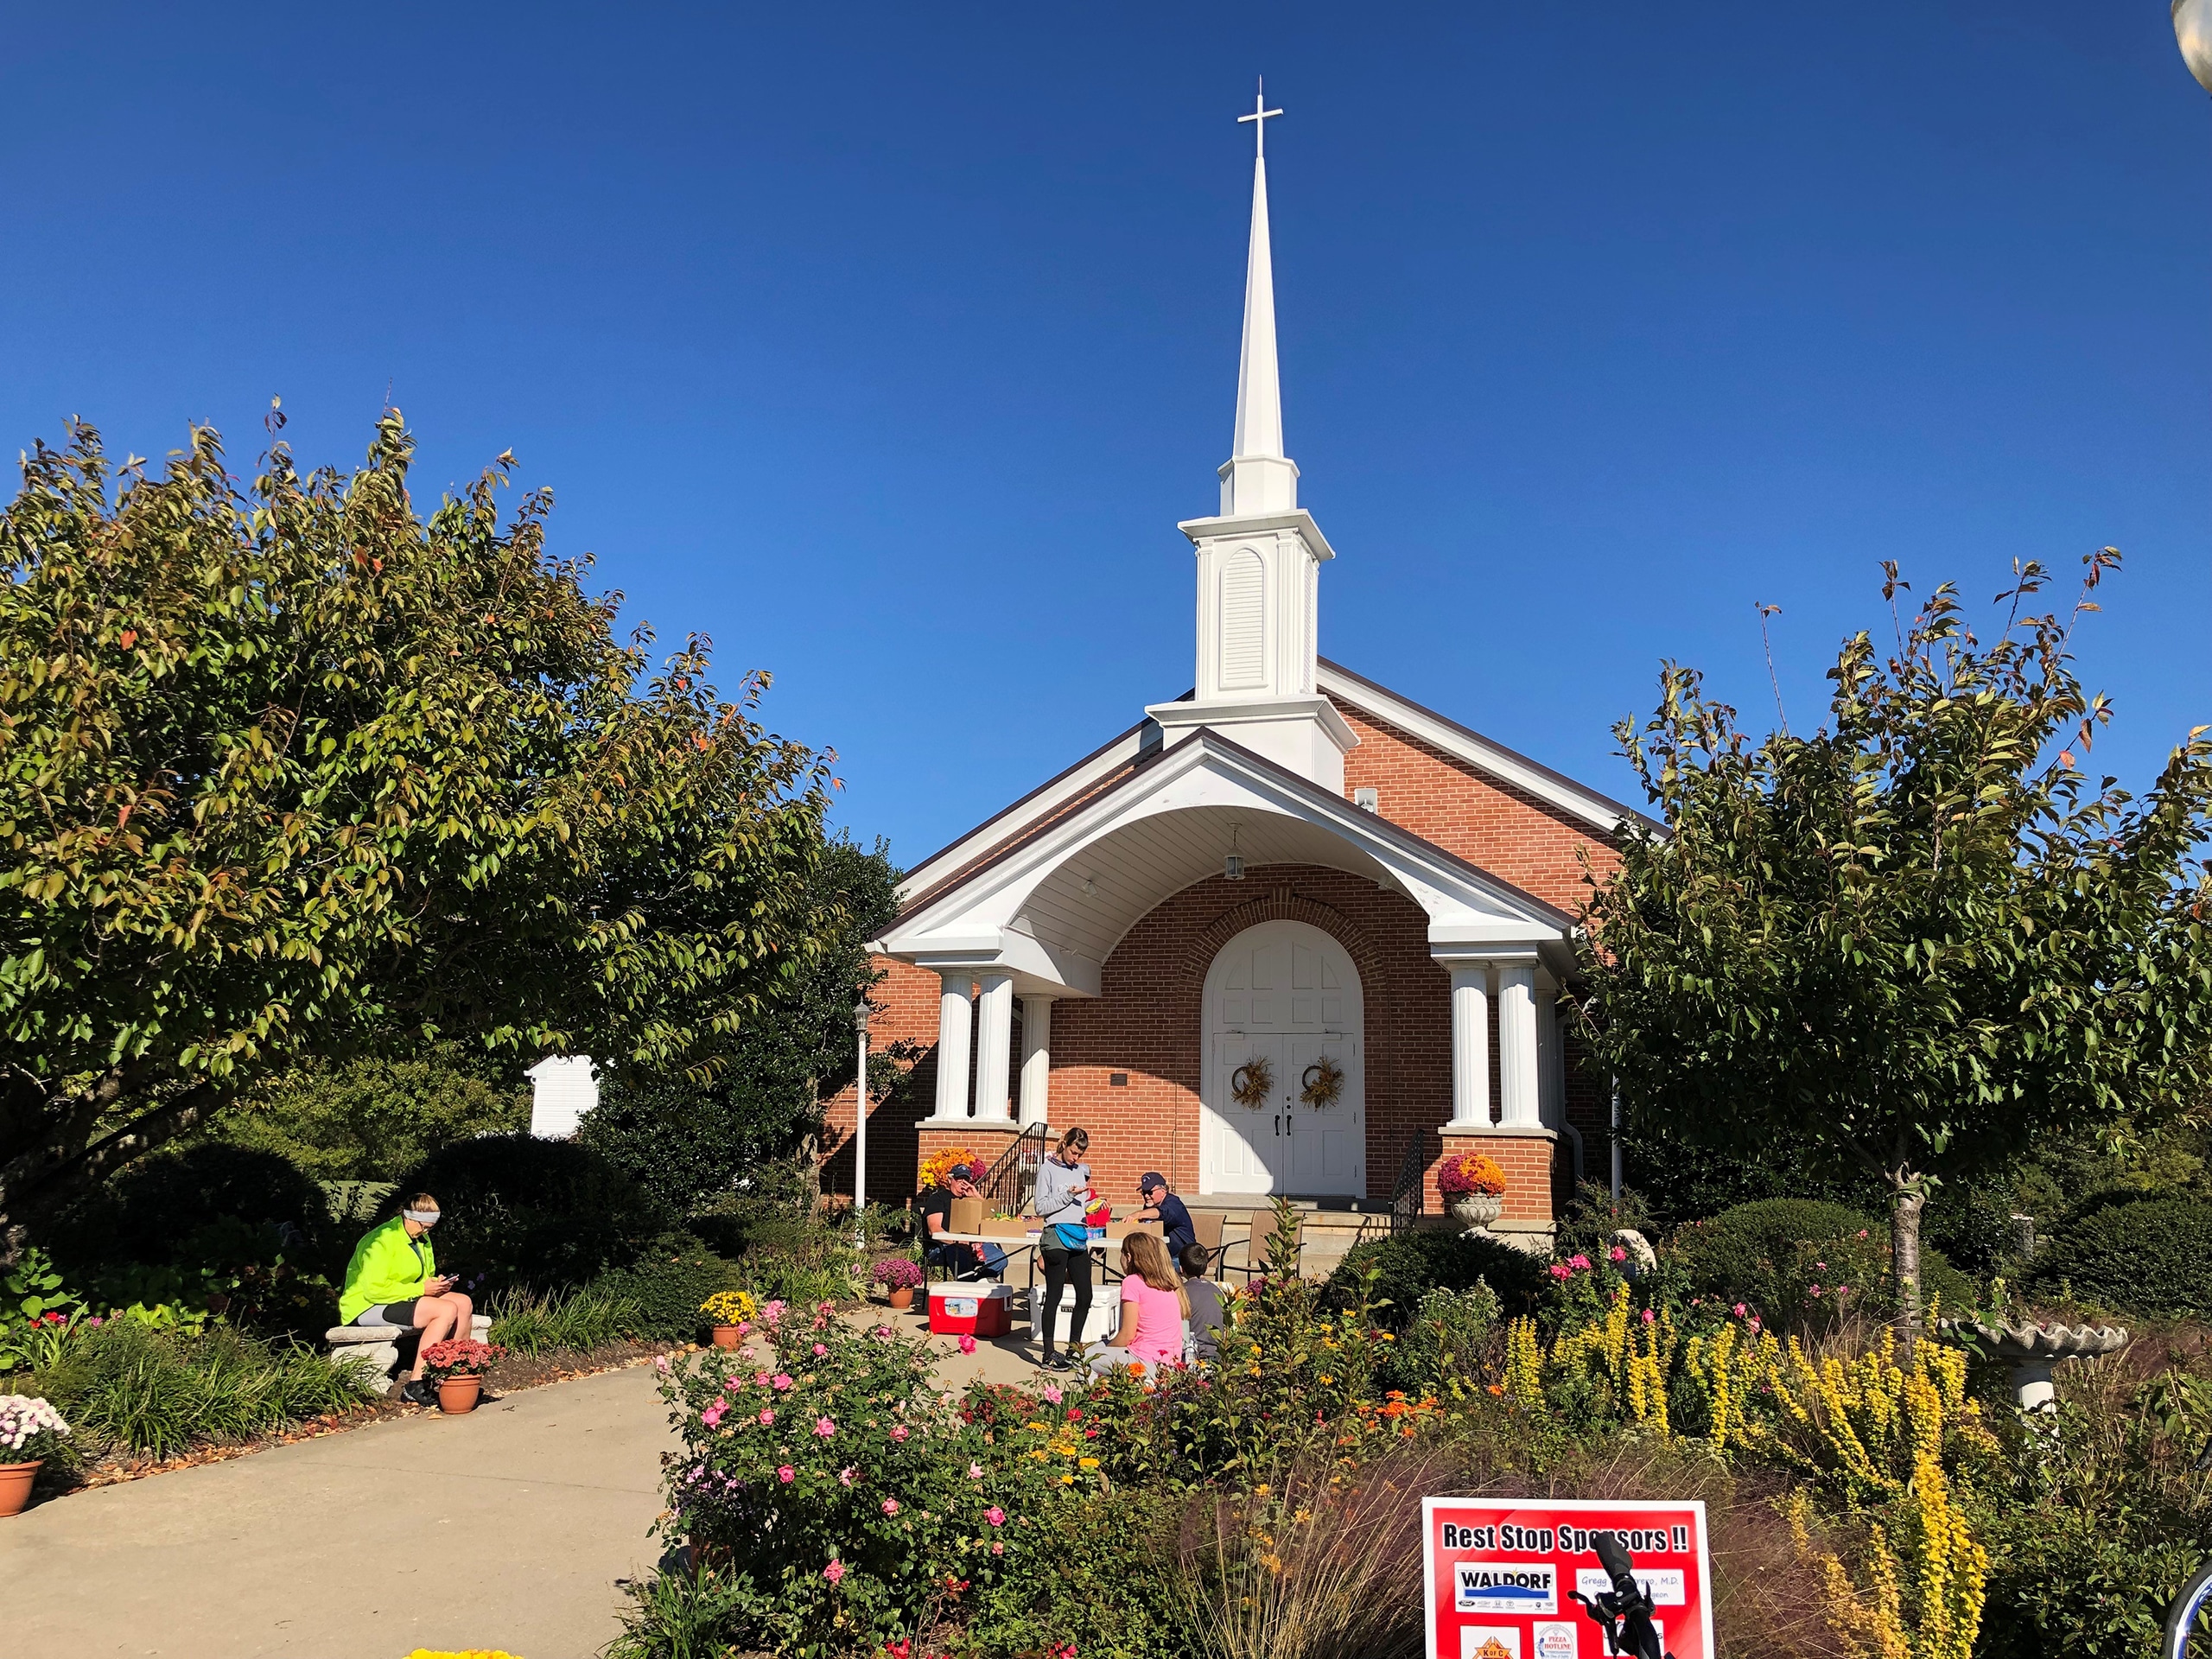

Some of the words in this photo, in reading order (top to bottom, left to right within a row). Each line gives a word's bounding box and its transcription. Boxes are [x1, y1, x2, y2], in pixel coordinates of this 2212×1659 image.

[1443, 1523, 1496, 1548] Rest
[1501, 1524, 1554, 1552] Stop
[1559, 1525, 1667, 1553] Sposors
[1460, 1572, 1552, 1589] WALDORF
[1581, 1576, 1607, 1587] Gregg
[1661, 1577, 1679, 1586] M.D.
